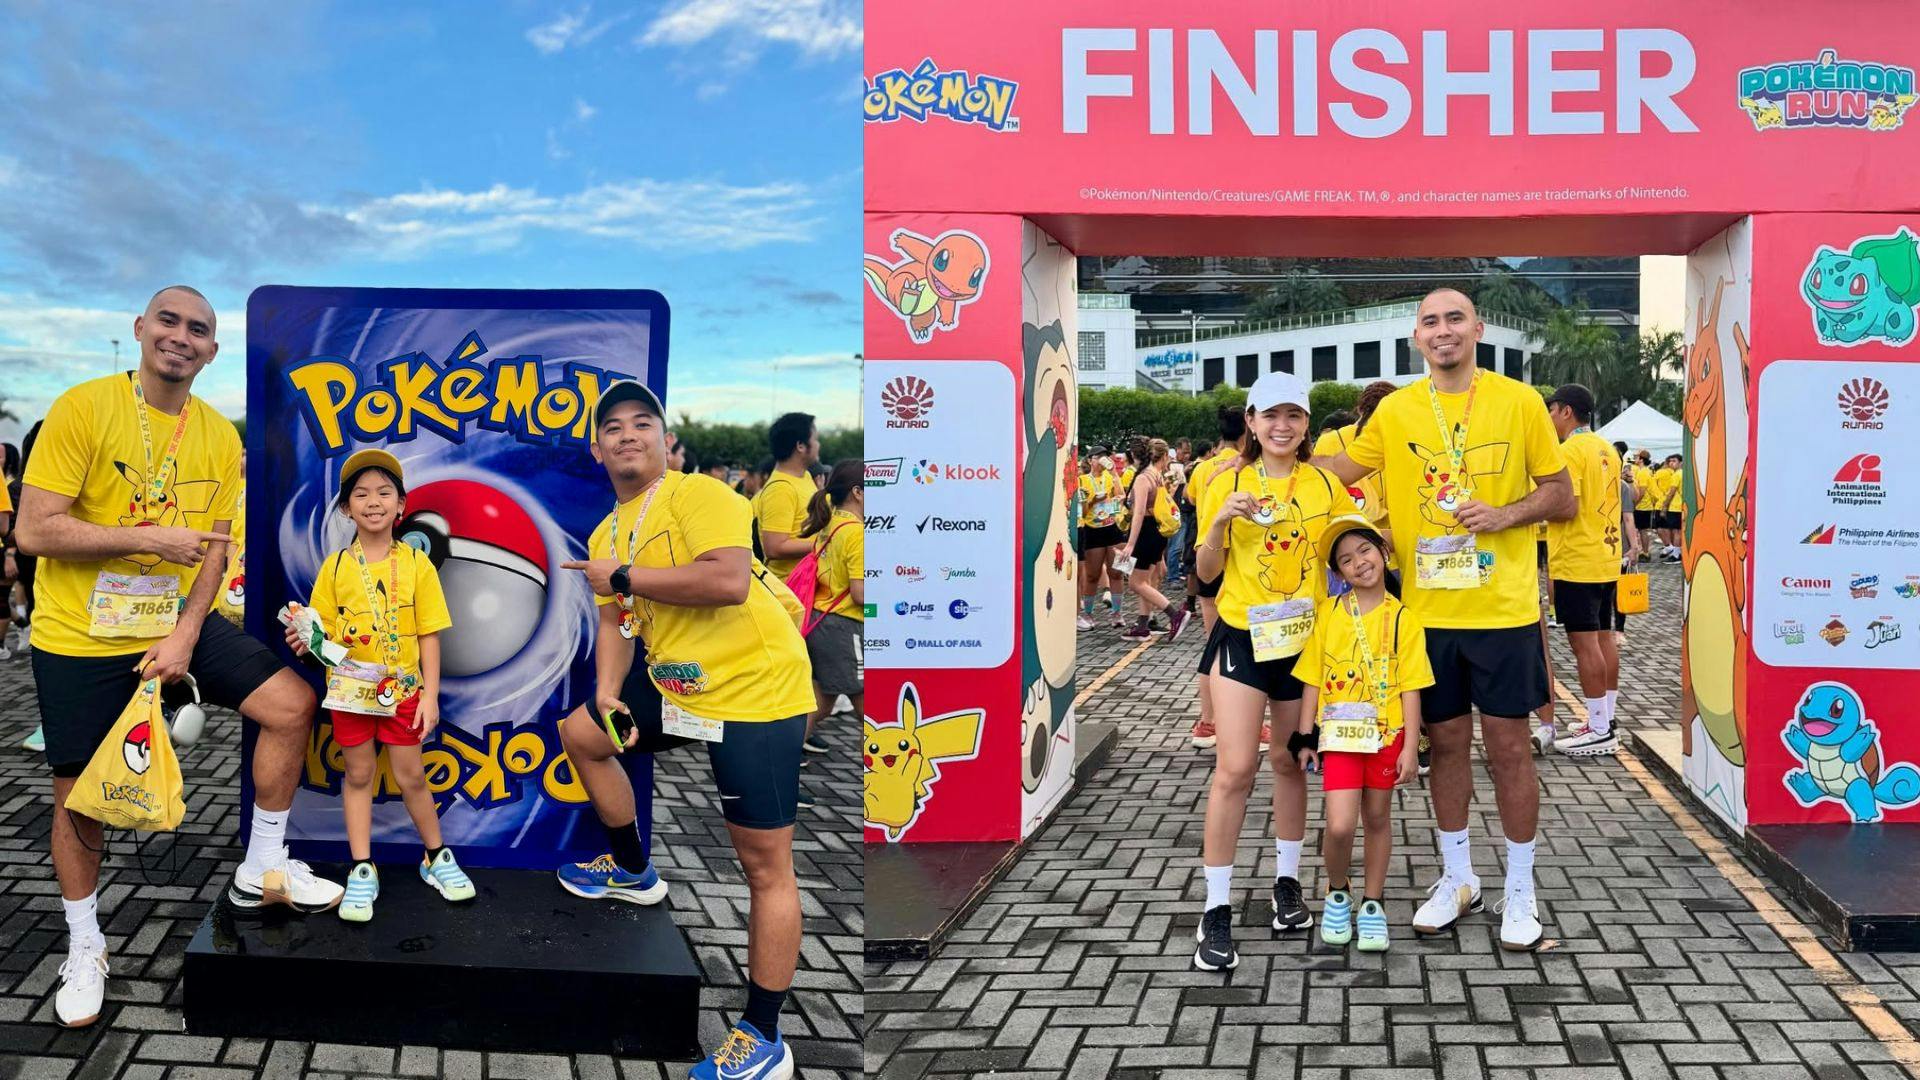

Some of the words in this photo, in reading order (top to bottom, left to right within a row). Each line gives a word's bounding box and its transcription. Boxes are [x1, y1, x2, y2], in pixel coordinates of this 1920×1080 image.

[1062, 28, 1700, 138] FINISHER
[1786, 91, 1869, 120] RUN
[1397, 191, 1420, 202] and
[1423, 190, 1478, 202] character
[1481, 191, 1521, 201] names
[1523, 191, 1542, 200] are
[1545, 189, 1612, 200] trademarks
[1615, 188, 1629, 199] of
[1630, 187, 1689, 199] Nintendo.
[886, 420, 930, 429] RUNRIO
[1841, 421, 1884, 430] RUNRIO
[945, 464, 1000, 480] klook
[1833, 483, 1881, 491] Animation
[1827, 490, 1886, 498] International
[1832, 497, 1882, 505] Philippines
[864, 515, 896, 530] HEYL
[932, 517, 986, 531] Rexona
[1839, 528, 1884, 538] Philippine
[1885, 529, 1920, 539] Airlines
[1436, 557, 1473, 570] 31865
[895, 565, 920, 576] Oishi
[1781, 576, 1831, 589] Canon
[129, 602, 174, 616] 31865
[910, 601, 935, 615] plus
[1279, 620, 1312, 638] 31299
[918, 640, 945, 648] MALL
[946, 640, 959, 648] OF
[959, 640, 982, 648] ASIA
[354, 686, 377, 700] 313
[1335, 726, 1375, 739] 31300
